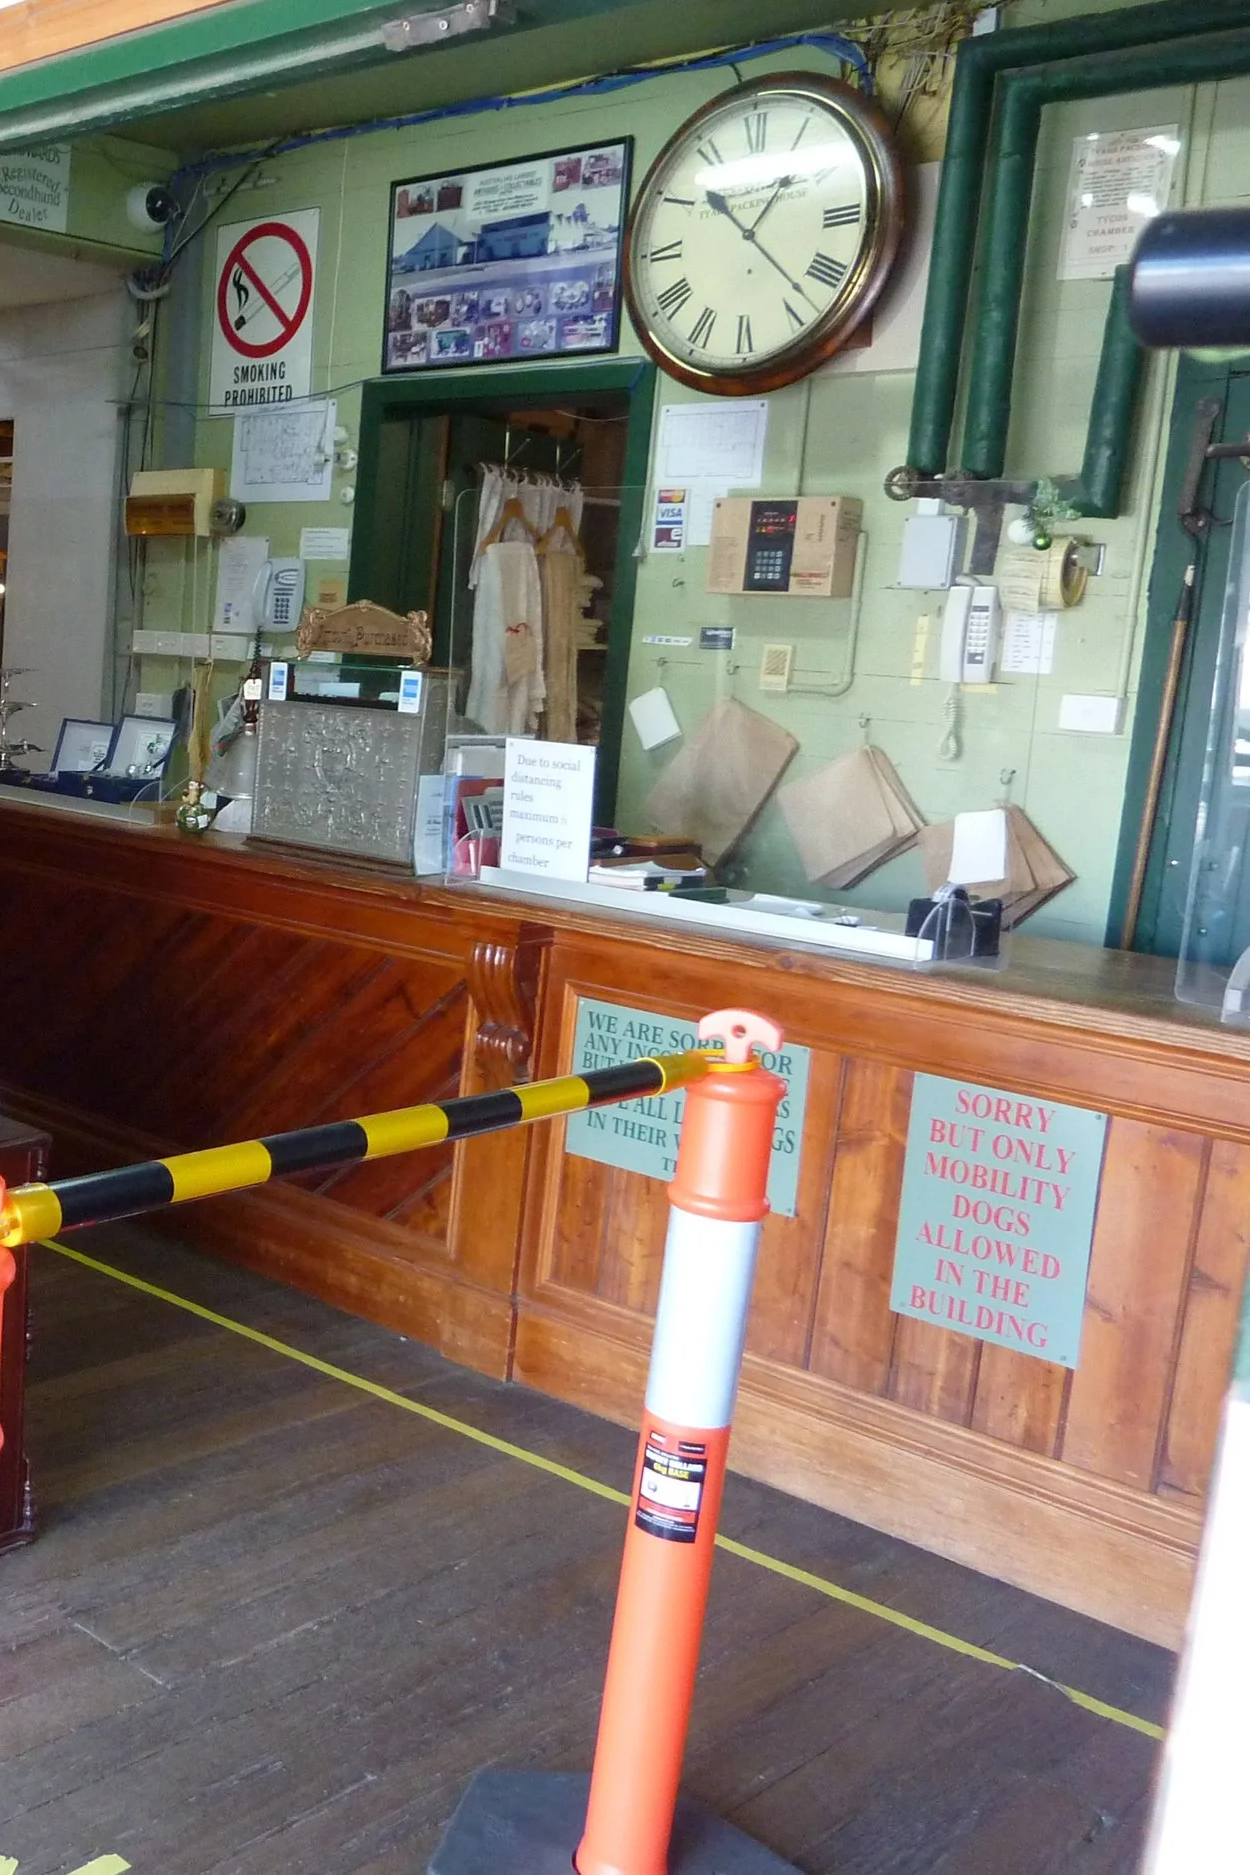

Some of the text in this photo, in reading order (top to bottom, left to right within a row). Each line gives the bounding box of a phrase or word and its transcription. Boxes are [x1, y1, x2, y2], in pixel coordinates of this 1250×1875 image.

[233, 361, 286, 384] SMOKING
[224, 384, 293, 408] PROHIBITED
[660, 507, 682, 519] VISA
[517, 753, 581, 772] Due to social
[511, 772, 562, 790] distancing
[510, 788, 534, 803] rules
[510, 807, 559, 825] maximum
[516, 831, 573, 850] persons per
[507, 851, 550, 868] chamber
[587, 1011, 618, 1034] WE
[622, 1021, 664, 1045] ARE
[584, 1032, 622, 1056] ANY
[582, 1051, 616, 1071] BUT
[632, 1096, 668, 1121] ALL
[955, 1089, 1057, 1133] SORRY
[587, 1110, 607, 1130] IN
[612, 1116, 667, 1148] THEIR
[929, 1118, 1076, 1174] BUT ONLY
[924, 1151, 1071, 1211] MOBILITY
[952, 1194, 1031, 1236] DOGS
[915, 1220, 1061, 1280] ALLOWED
[935, 1258, 1030, 1308] IN THE
[910, 1285, 1048, 1348] BUILDING
